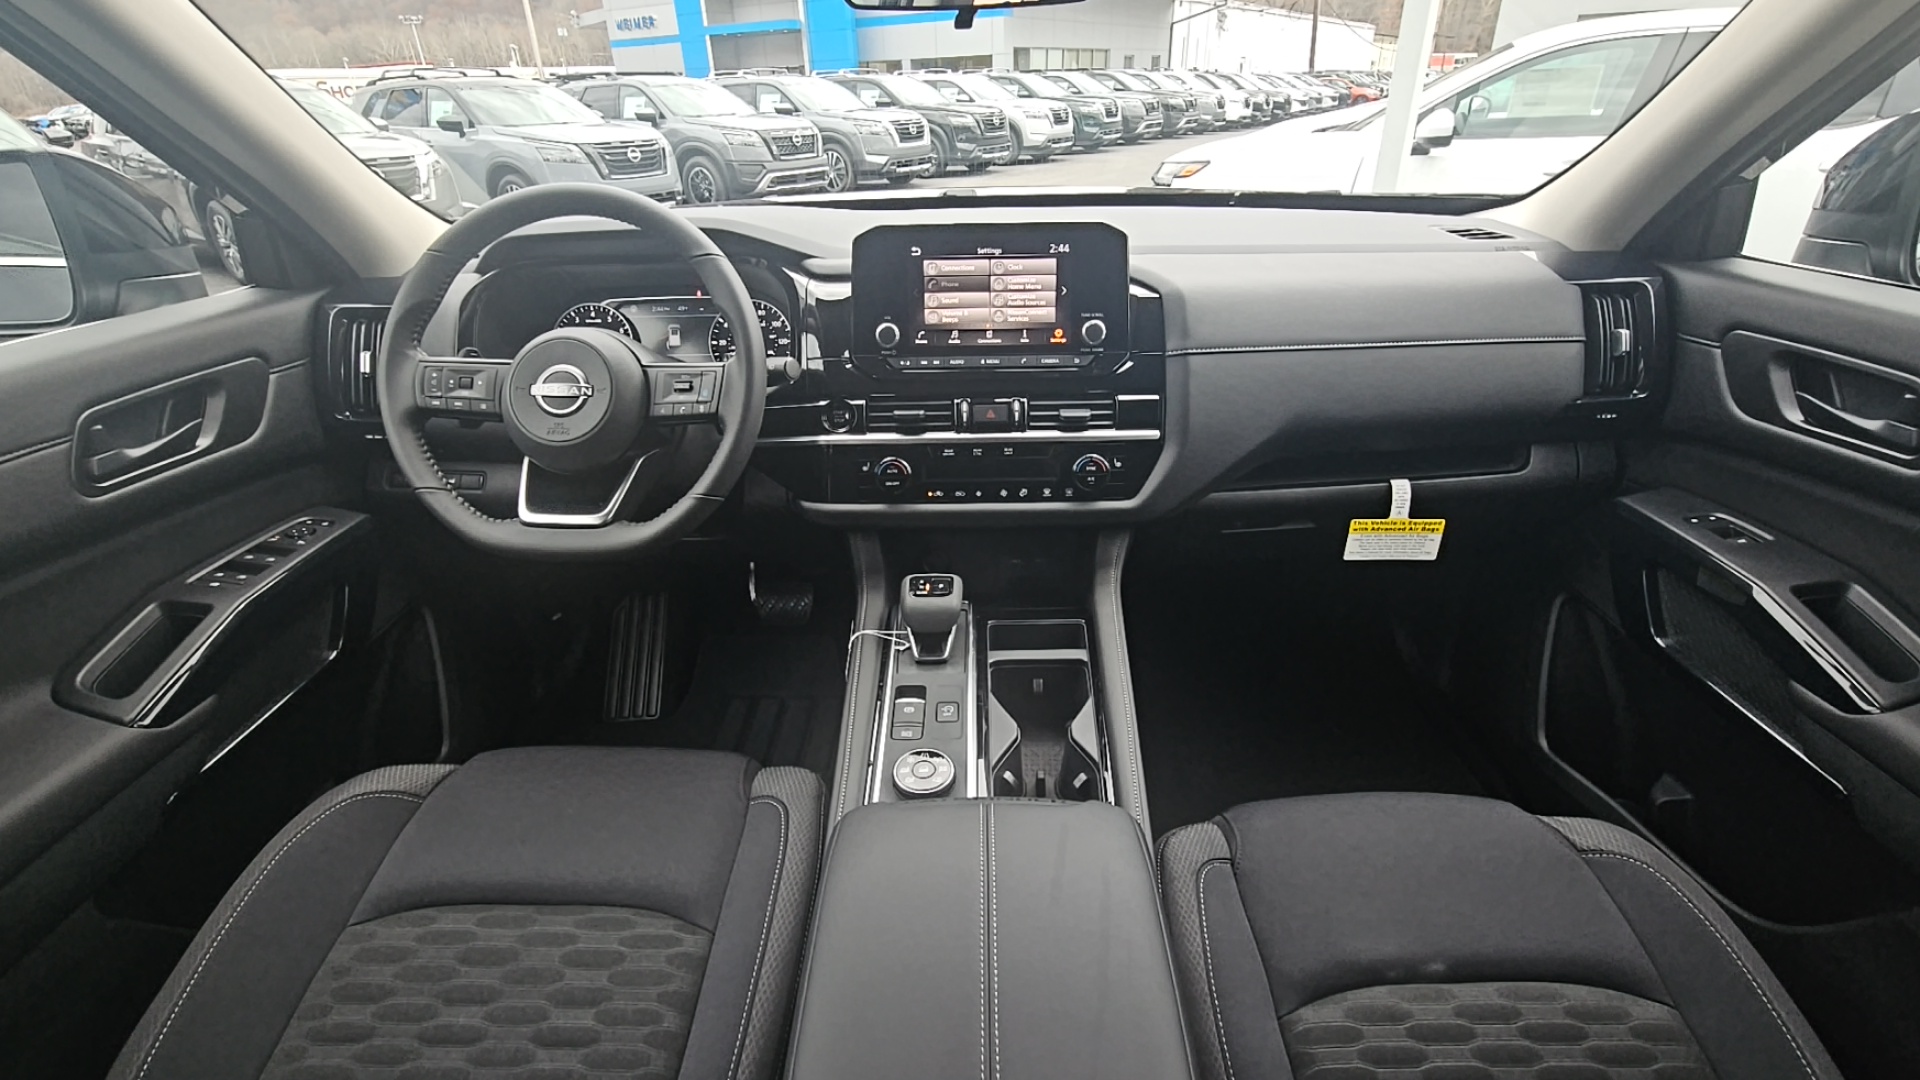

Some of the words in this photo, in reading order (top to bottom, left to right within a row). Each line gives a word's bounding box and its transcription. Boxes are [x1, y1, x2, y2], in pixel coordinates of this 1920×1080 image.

[977, 247, 1002, 255] Settings
[1049, 244, 1070, 253] 2:44
[941, 280, 959, 288] Phone
[531, 384, 593, 396] NISSAN
[1408, 520, 1443, 528] Equipped
